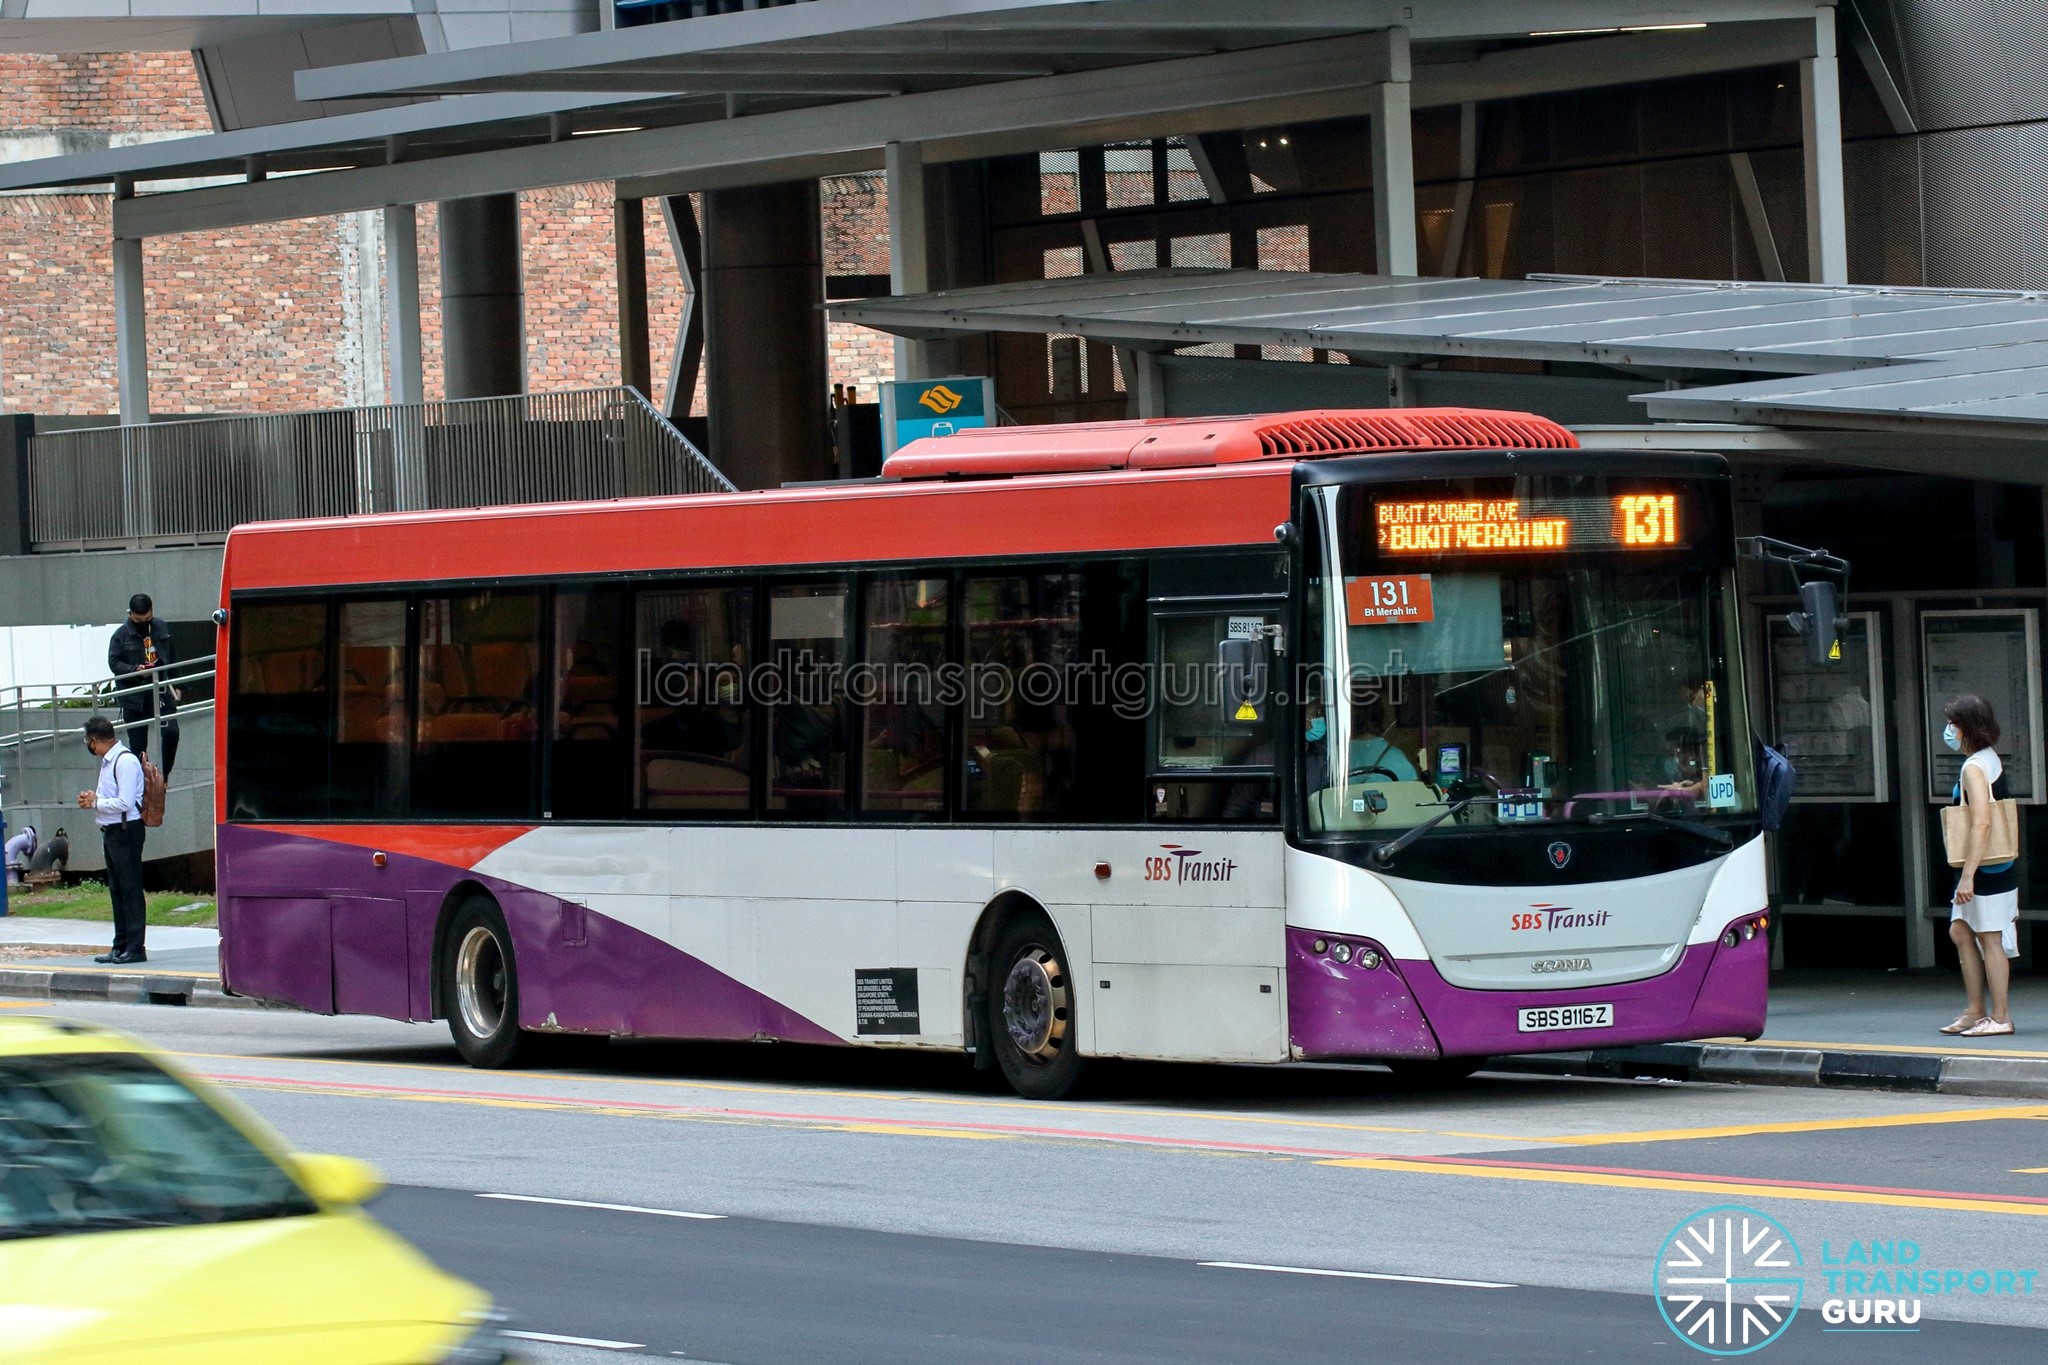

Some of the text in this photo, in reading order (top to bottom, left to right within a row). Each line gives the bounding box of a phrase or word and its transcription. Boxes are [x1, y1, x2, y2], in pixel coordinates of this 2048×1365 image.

[1379, 502, 1519, 523] BUKIT PURMEI AVE
[1620, 495, 1675, 543] 131
[1390, 521, 1567, 549] BUKIT MERAH INT
[1370, 580, 1409, 606] 131
[1364, 606, 1418, 617] Bt Merah Int
[1710, 782, 1734, 800] UPD
[1144, 850, 1238, 886] SBS Transit
[1511, 907, 1614, 933] SBS Transit
[1530, 958, 1593, 974] SCANIA
